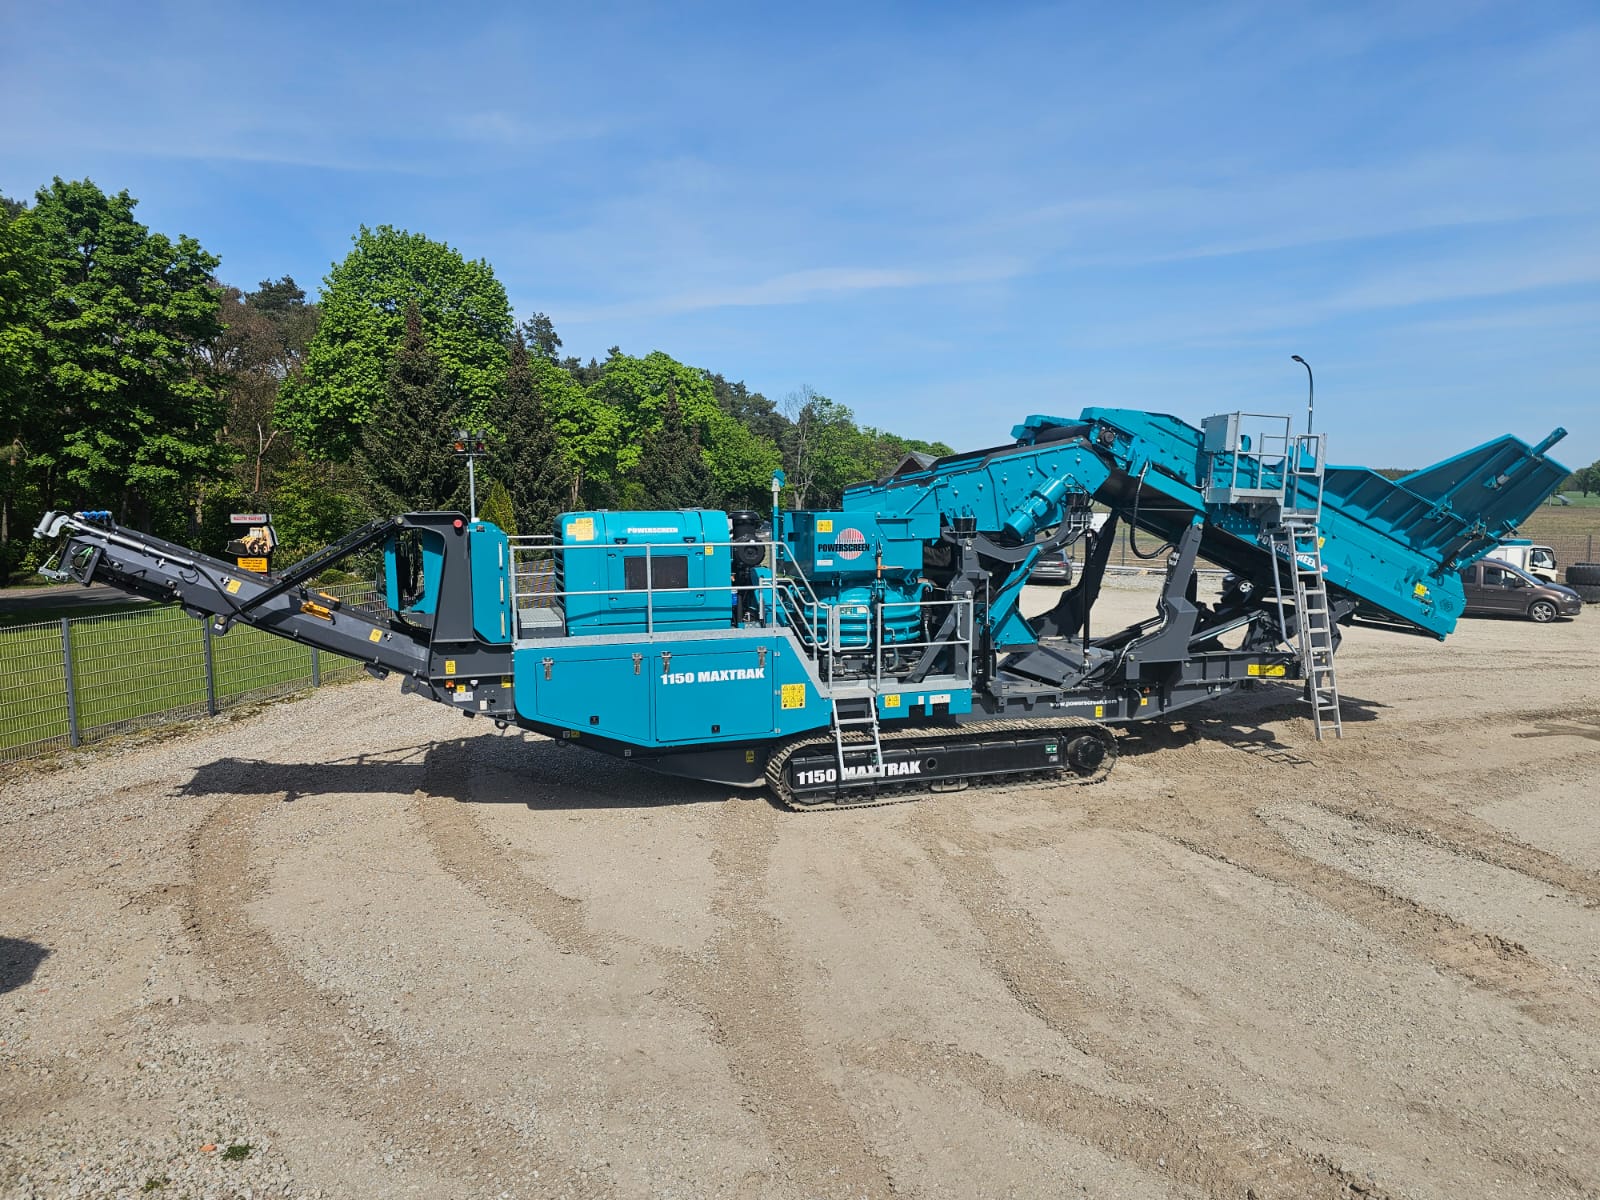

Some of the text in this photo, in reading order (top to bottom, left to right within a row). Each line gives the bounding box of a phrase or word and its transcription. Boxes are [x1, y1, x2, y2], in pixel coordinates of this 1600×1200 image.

[627, 527, 679, 535] POWERSCREEN
[817, 543, 870, 553] POWERSCREEN
[660, 667, 765, 685] 1150 MAXTRAK
[797, 768, 837, 785] 1150
